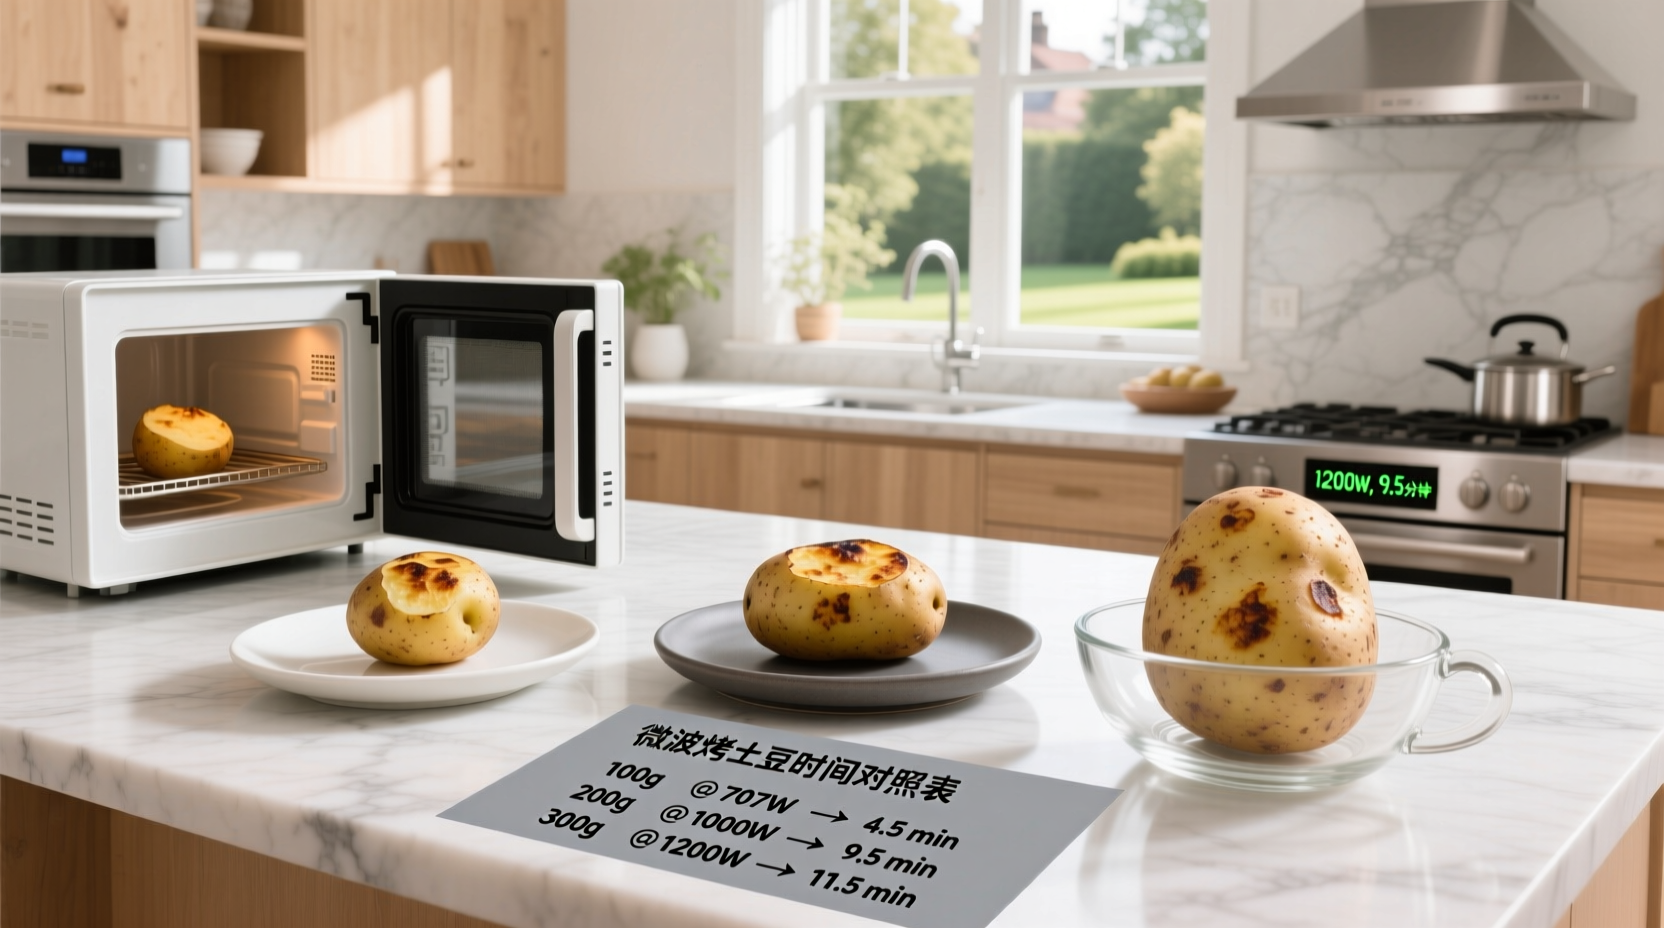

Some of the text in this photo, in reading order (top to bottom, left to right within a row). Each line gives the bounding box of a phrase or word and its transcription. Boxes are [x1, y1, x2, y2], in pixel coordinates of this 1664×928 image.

[1315, 469, 1374, 496] 1200W,
[605, 761, 666, 790] 100g
[863, 816, 909, 838] 4.5
[905, 828, 960, 851] min
[632, 723, 962, 804] 微波烤土豆时间对照表
[538, 807, 606, 840] 300g
[809, 868, 866, 895] 11.5
[861, 885, 917, 909] min
[569, 784, 637, 815] 200g
[841, 843, 887, 866] 9.5
[883, 856, 938, 879] min
